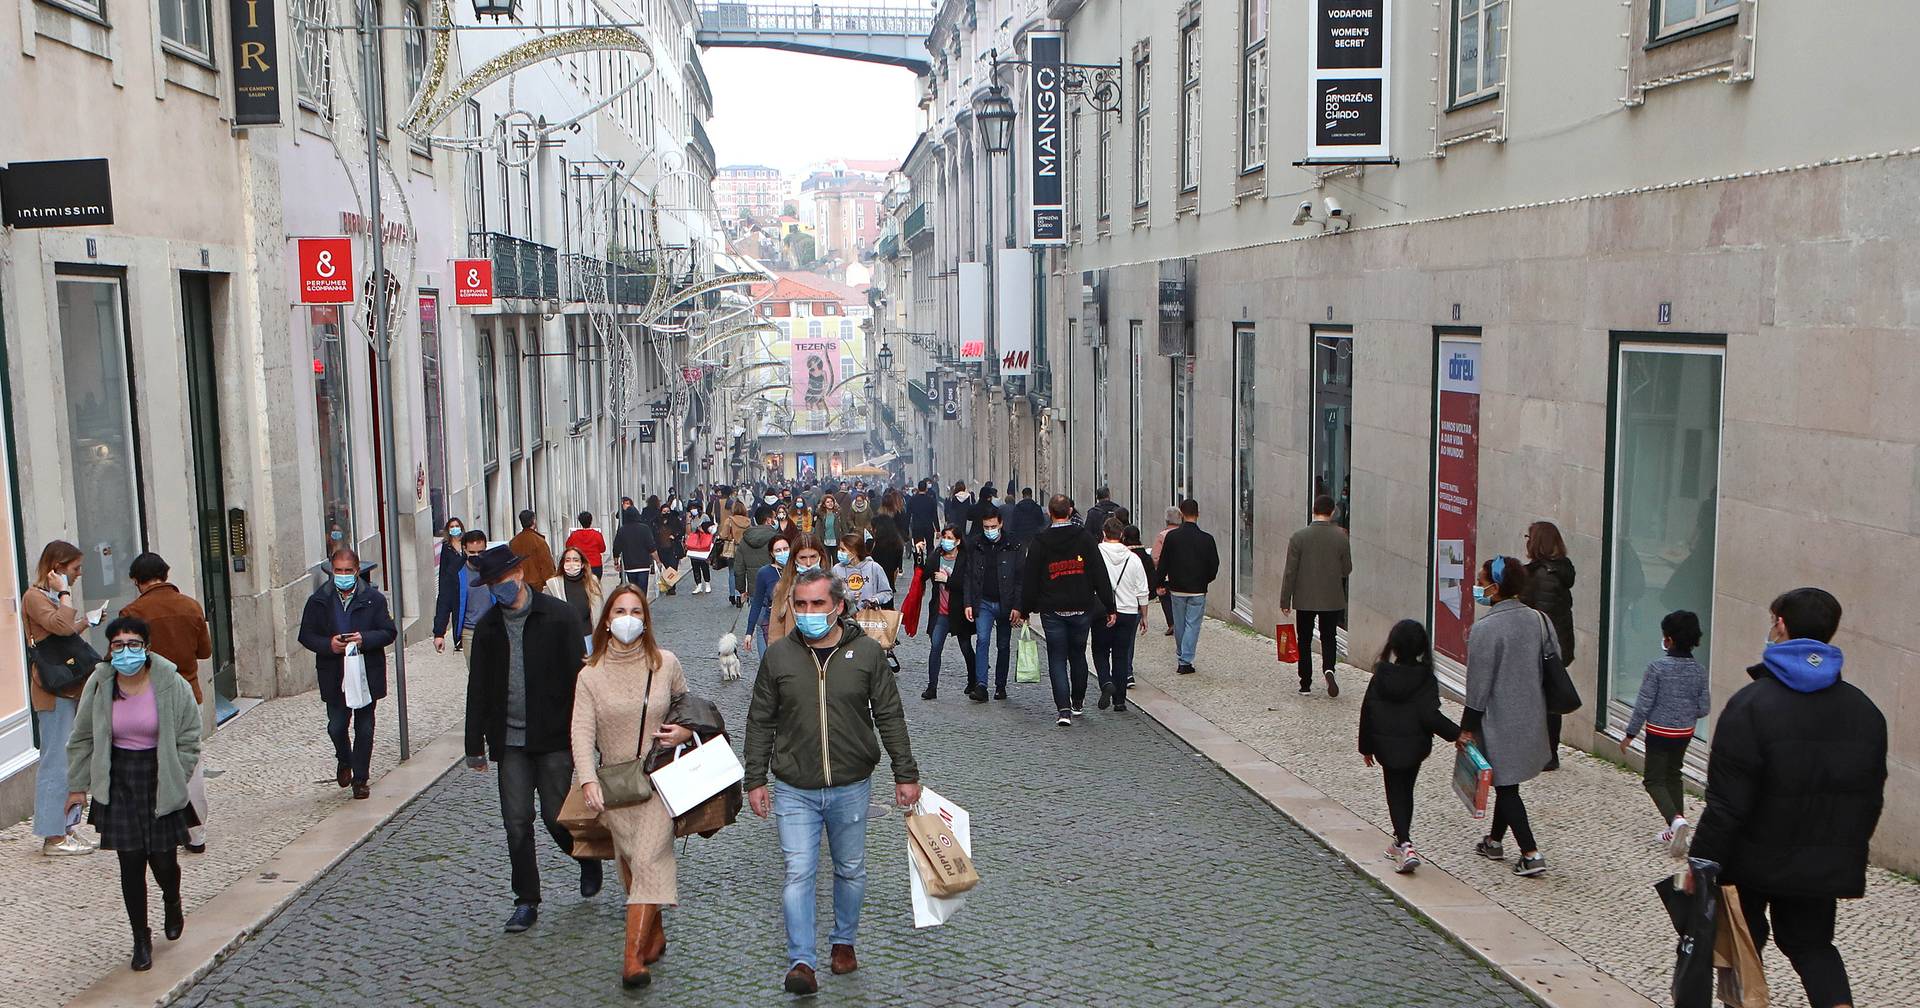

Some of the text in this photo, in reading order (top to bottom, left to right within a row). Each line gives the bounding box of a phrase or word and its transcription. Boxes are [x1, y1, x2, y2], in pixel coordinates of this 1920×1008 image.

[1328, 9, 1373, 18] VODAFONE
[1331, 27, 1370, 37] WOMEN'S
[1335, 39, 1366, 48] SECRET
[1326, 102, 1340, 111] DO
[1325, 110, 1360, 120] CHIADO
[1037, 67, 1057, 177] MANGO
[18, 206, 105, 218] intimissimi
[306, 279, 347, 287] PERFUMES
[1660, 304, 1669, 322] 12
[795, 342, 837, 351] TEZENIS
